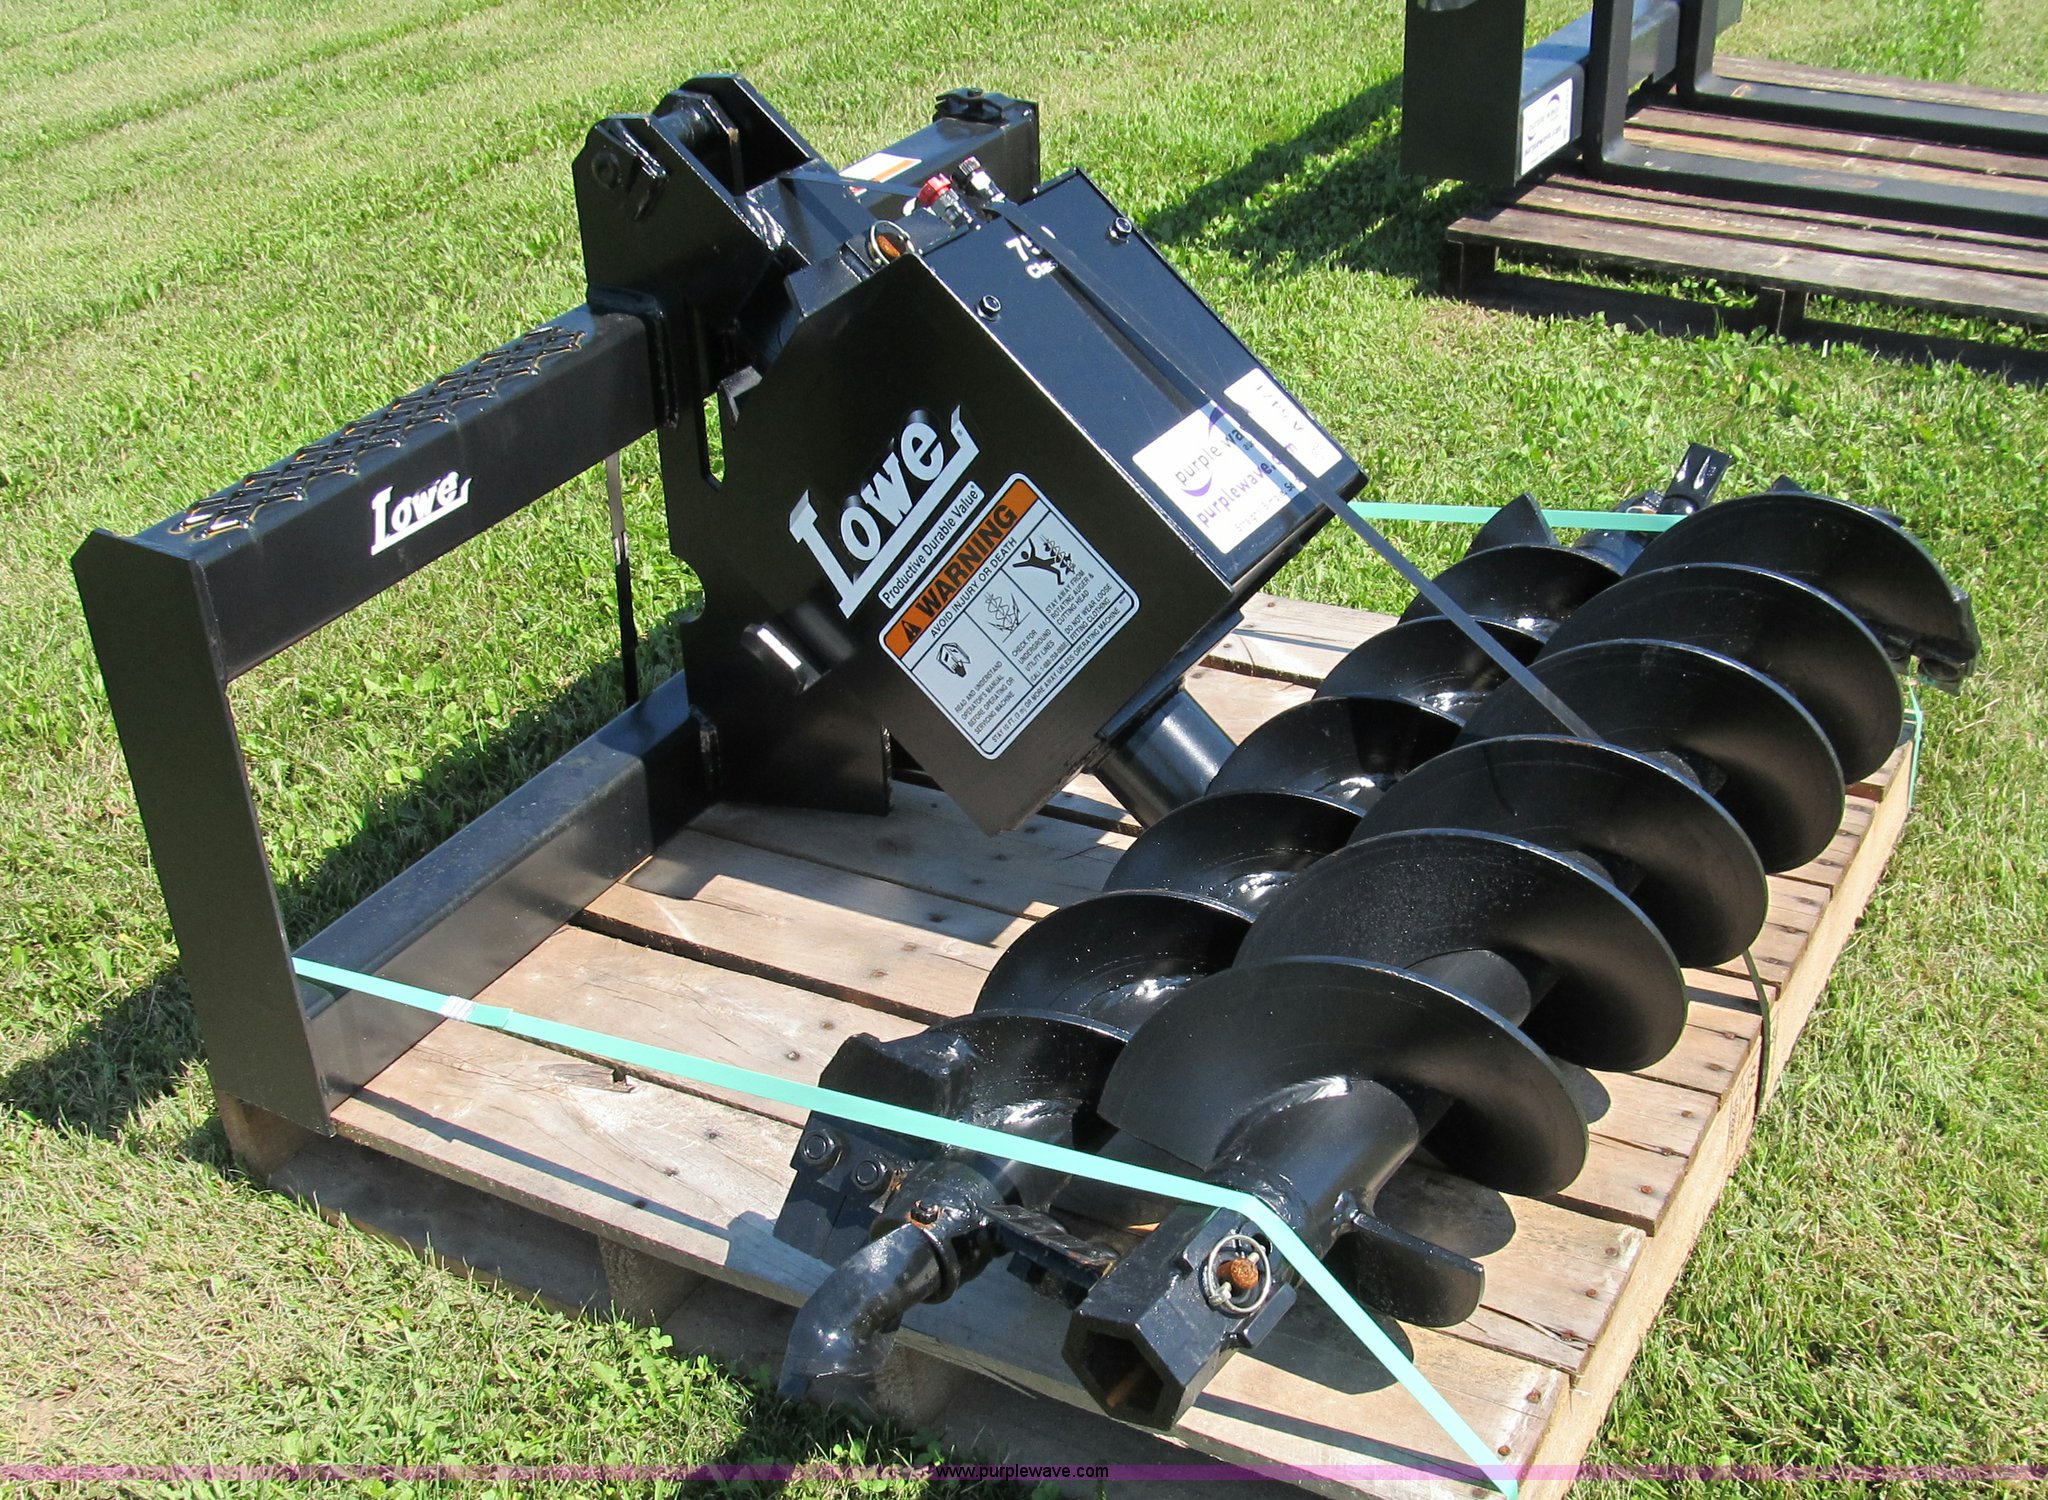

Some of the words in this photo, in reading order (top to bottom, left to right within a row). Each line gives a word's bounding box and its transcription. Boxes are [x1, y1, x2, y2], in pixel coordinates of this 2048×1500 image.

[1175, 445, 1222, 485] purple
[371, 471, 472, 555] Lowe
[789, 404, 980, 618] Lowe
[882, 553, 923, 605] Productive
[921, 520, 955, 567] Durable
[916, 504, 1018, 619] WARNING
[930, 610, 954, 639] AVOID
[951, 579, 979, 613] INJURY
[978, 566, 993, 582] OR
[989, 536, 1018, 569] DEATH
[1045, 598, 1059, 614] STAY
[1057, 583, 1072, 602] AWAY
[1069, 569, 1085, 586] FROM
[1050, 593, 1075, 620] ROTATING
[1072, 576, 1090, 597] AUGER
[1056, 603, 1078, 626] CUTTING
[1074, 589, 1090, 606] HEAD
[1081, 599, 1097, 617] WEAR
[1094, 582, 1113, 603] LOOSE
[1069, 620, 1089, 641] FITTING
[1086, 597, 1111, 623] CLOTHING
[1011, 639, 1029, 658] CHECK
[1017, 628, 1052, 665] UNDERGROUND
[1024, 652, 1042, 672] UTILITY
[1040, 639, 1055, 656] LINES
[1030, 685, 1046, 701] MORE
[1043, 671, 1058, 689] AWAY
[1055, 654, 1076, 675] UNLESS
[1073, 628, 1101, 657] OPERATING
[1097, 606, 1121, 631] MACHINE
[954, 698, 968, 713] READ
[974, 660, 1003, 692] UNDERSTAND
[967, 708, 986, 728] BEFORE
[983, 683, 1008, 711] OPERATING
[984, 674, 1005, 694] MANUAL
[974, 710, 997, 735] SERVICING
[994, 690, 1015, 713] MACHINE
